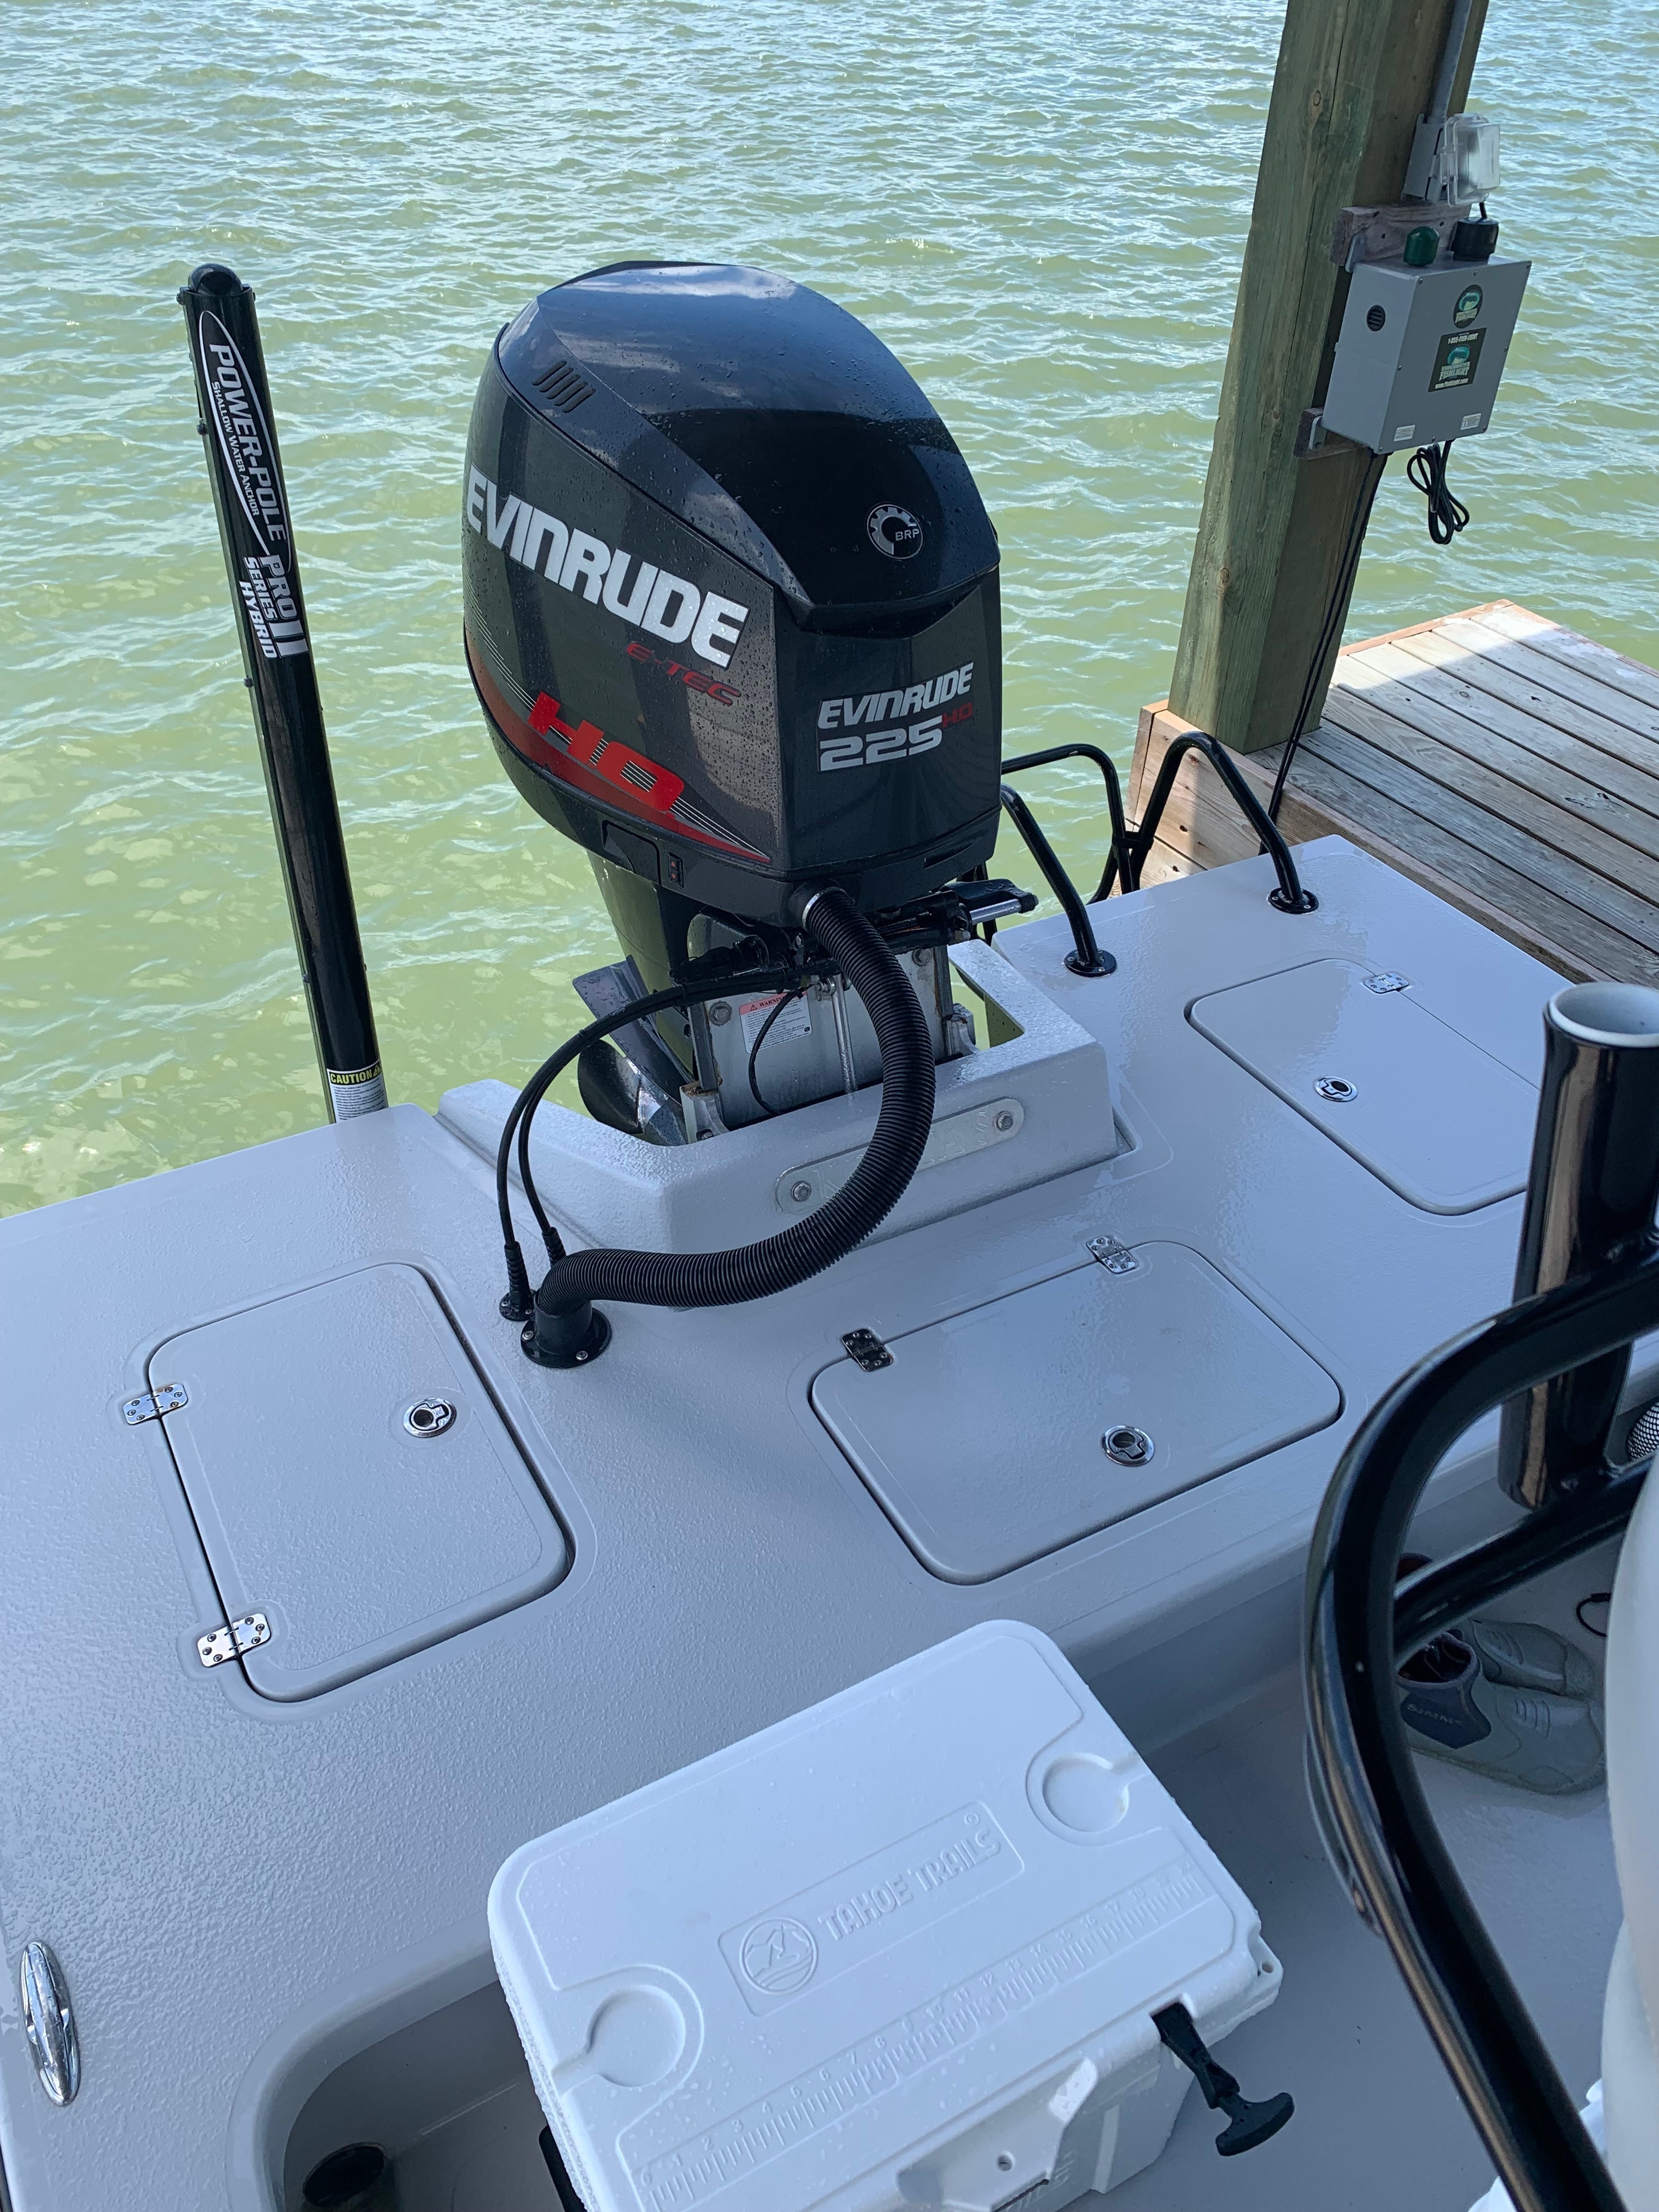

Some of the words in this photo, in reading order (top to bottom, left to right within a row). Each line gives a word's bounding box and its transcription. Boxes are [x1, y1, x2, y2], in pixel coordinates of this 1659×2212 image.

[210, 345, 287, 541] POWER-POLE
[212, 381, 233, 433] SHALLOW
[228, 435, 246, 473] WATER
[240, 475, 261, 516] ANCHOR
[466, 462, 751, 668] EVINRUDE
[895, 528, 920, 541] BRP
[239, 581, 278, 658] HYBRID
[244, 557, 278, 620] SERIES
[258, 554, 297, 620] PRO
[626, 641, 741, 706] E-TEC
[817, 662, 974, 729] EVINRUDE
[527, 691, 685, 812] HO
[820, 715, 943, 772] 225
[941, 702, 974, 728] HO
[330, 1069, 373, 1084] CAUTION
[817, 1874, 913, 1941] TAHOE
[907, 1828, 1002, 1892] TRAILS
[702, 2136, 714, 2151] 2
[731, 2119, 744, 2132] 3
[791, 2084, 803, 2098] 5
[819, 2067, 831, 2081] 6
[846, 2051, 857, 2066] 7
[874, 2036, 886, 2048] 8
[953, 1987, 970, 2001] 11
[979, 1972, 995, 1988] 12
[1005, 1957, 1023, 1972] 13
